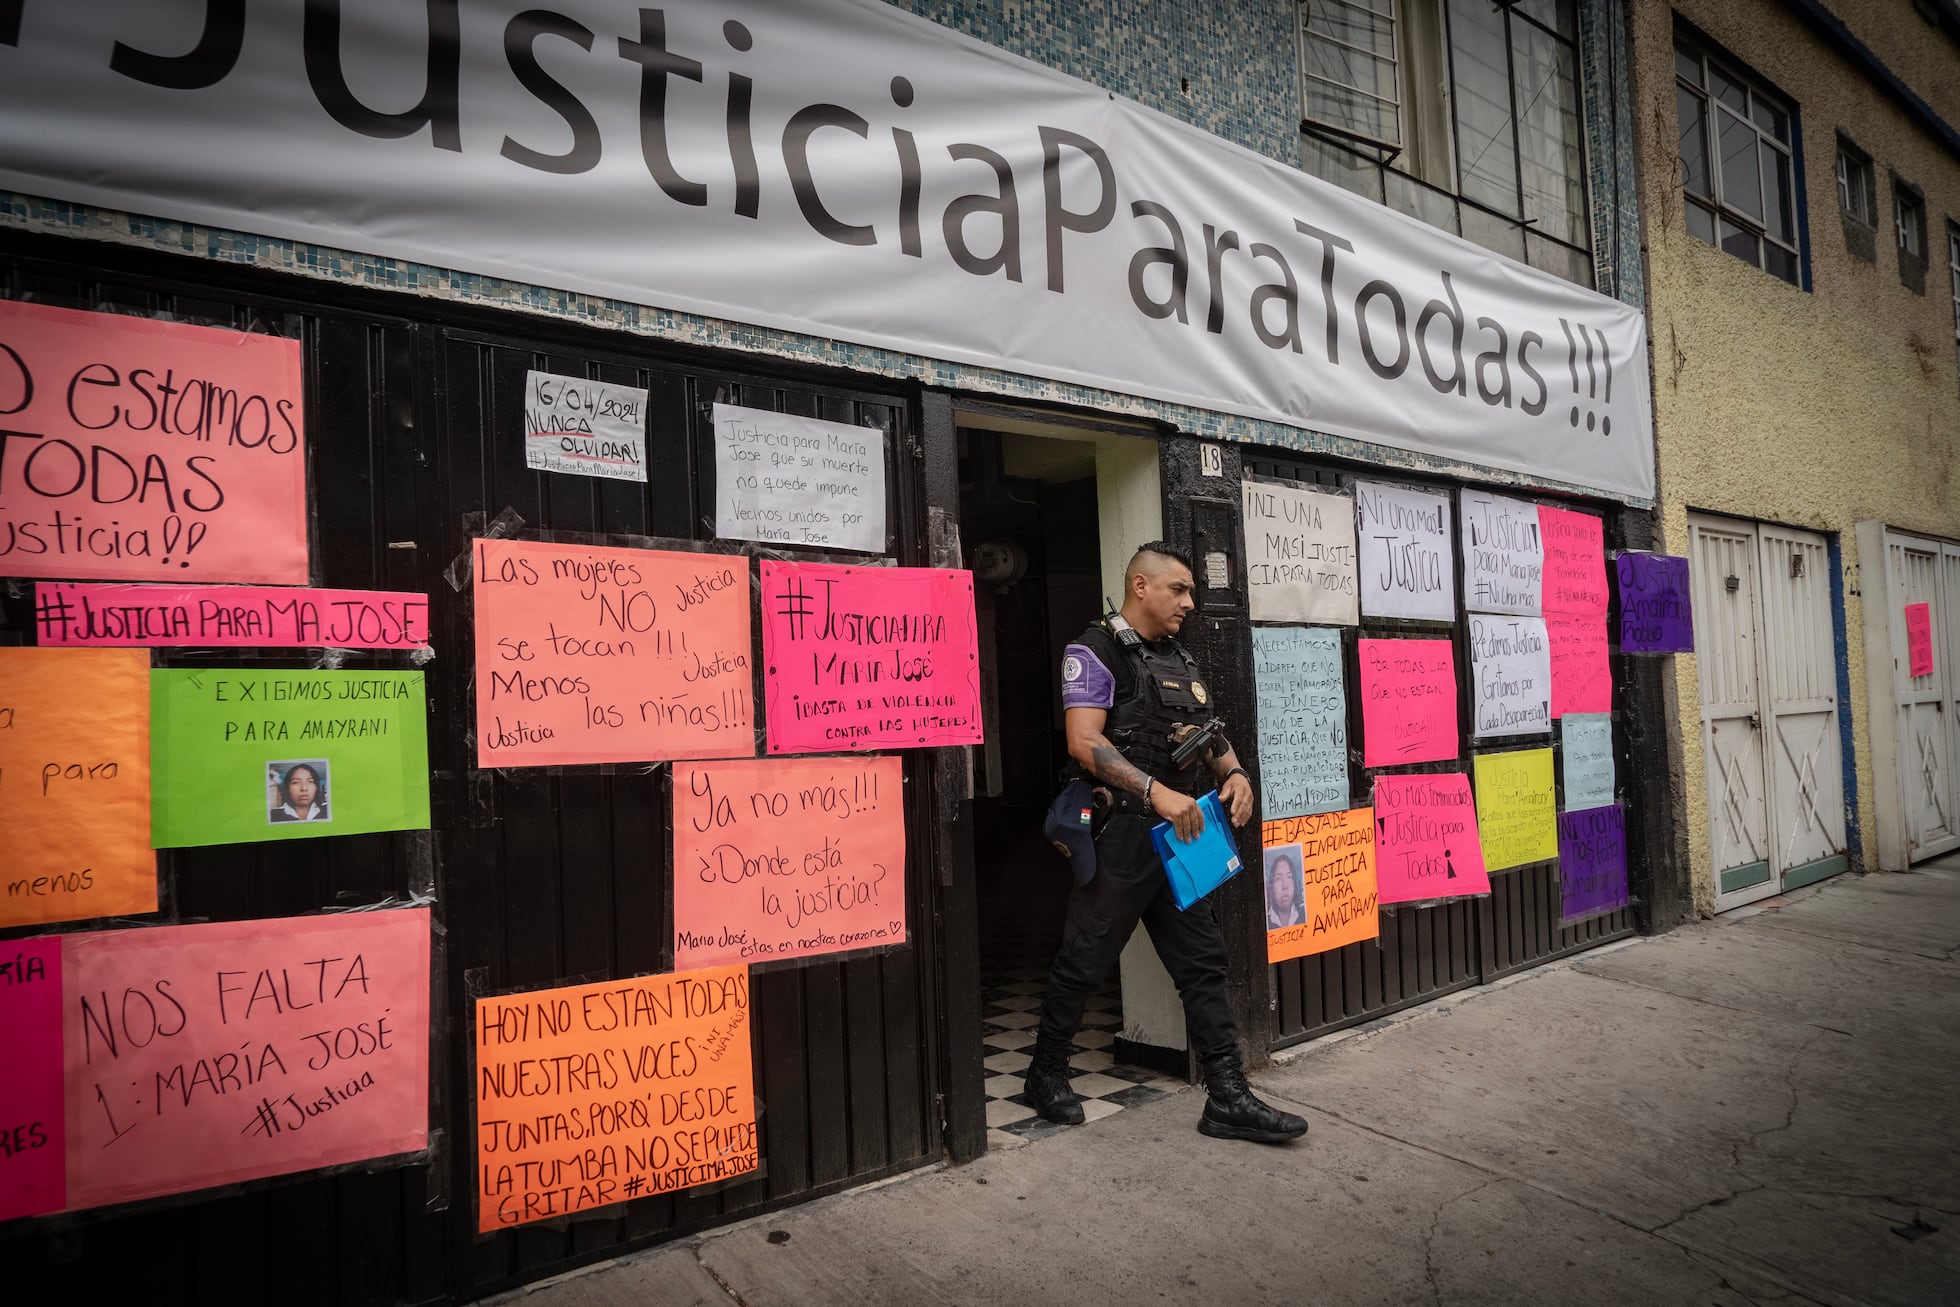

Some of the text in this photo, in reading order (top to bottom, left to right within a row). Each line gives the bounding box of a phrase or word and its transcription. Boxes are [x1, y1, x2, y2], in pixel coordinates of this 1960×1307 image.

[0, 0, 1548, 417] usticiaParaTodas
[67, 363, 298, 454] estamos
[535, 376, 639, 425] 16/04/2024
[526, 408, 592, 435] NUNCA
[722, 420, 788, 447] Justicia
[793, 435, 820, 452] para
[728, 444, 869, 476] Jose que su muerte
[1202, 445, 1220, 471] 18
[736, 476, 858, 498] no quede impune
[731, 499, 863, 527] Vecinos unidos por
[1283, 498, 1322, 530] UNA
[0, 508, 207, 568] usticia!!
[800, 528, 829, 543] Jose
[481, 543, 642, 600] Las mujeres
[1317, 572, 1354, 596] TODAS
[599, 590, 656, 633] NO
[497, 637, 535, 661] se
[545, 622, 636, 657] tocan
[1321, 656, 1335, 675] NO
[216, 679, 409, 701] EXIGIMOS JUSTICIA
[491, 670, 590, 702] Menos
[857, 698, 875, 710] DE
[882, 695, 956, 709] VIOLENCIA
[225, 718, 388, 741] PARA AMAYRANI
[585, 696, 624, 730] las
[826, 725, 871, 739] CONTRA
[879, 719, 903, 732] LAS
[1273, 716, 1286, 729] NO
[1291, 717, 1304, 727] DE
[1315, 716, 1328, 727] LA
[42, 763, 118, 796] para
[1377, 777, 1400, 808] No
[691, 770, 736, 833] Ya
[751, 792, 788, 818] no
[1440, 822, 1464, 848] para
[695, 836, 843, 884] ¿Donde está
[1305, 851, 1367, 885] JUSTICIA
[8, 867, 93, 900] menos
[761, 863, 886, 929] la justicia?
[1322, 879, 1354, 907] PARA
[779, 940, 793, 952] en
[840, 929, 887, 946] corazones
[80, 953, 370, 1064] NOS FALTA
[482, 973, 747, 1045] HOY NO ESTAN TODAS
[155, 1041, 287, 1116] MARÍA
[482, 1036, 697, 1100] NUESTRAS VOCES
[240, 1070, 375, 1138] #Justicia
[660, 1086, 738, 1126] DESDE
[626, 1136, 669, 1173] NO
[498, 1179, 617, 1223] GRITAR
